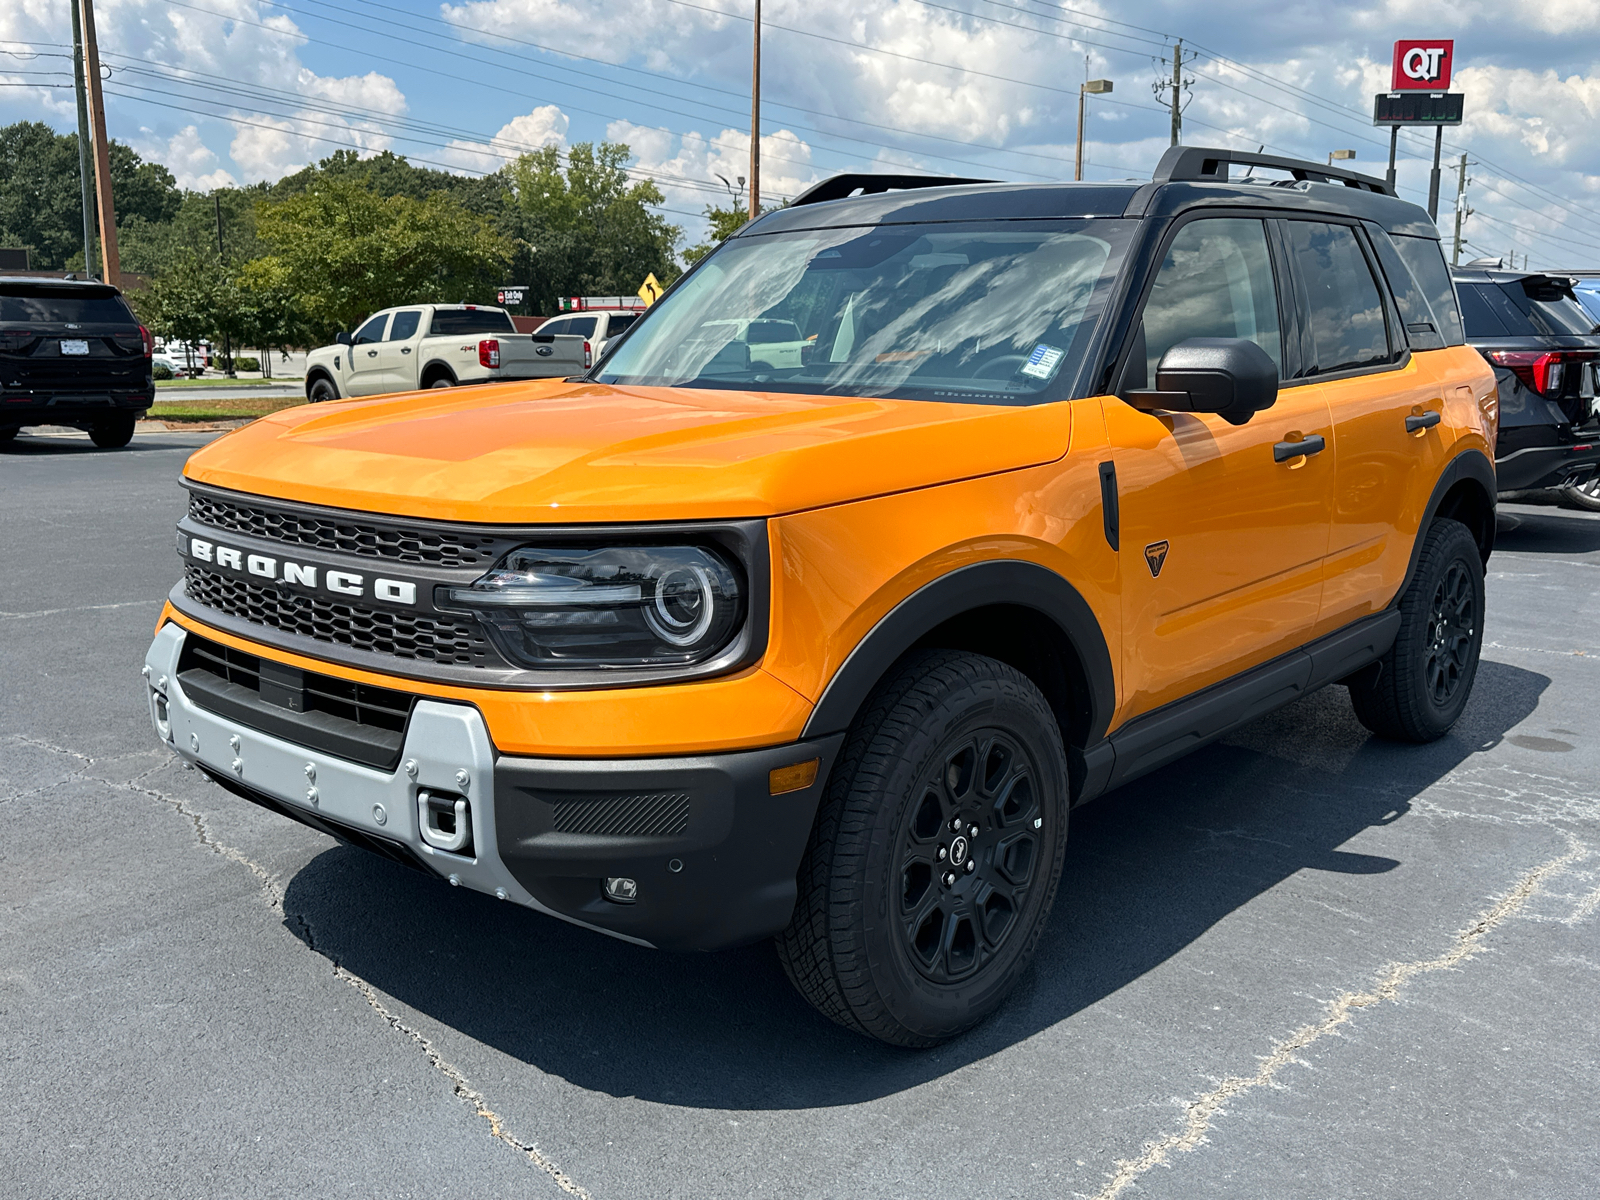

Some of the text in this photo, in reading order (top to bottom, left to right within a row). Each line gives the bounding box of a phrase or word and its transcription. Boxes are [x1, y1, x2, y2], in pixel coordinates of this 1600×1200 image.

[1402, 47, 1445, 81] QT
[513, 290, 523, 301] Only
[191, 538, 417, 605] BRONCO
